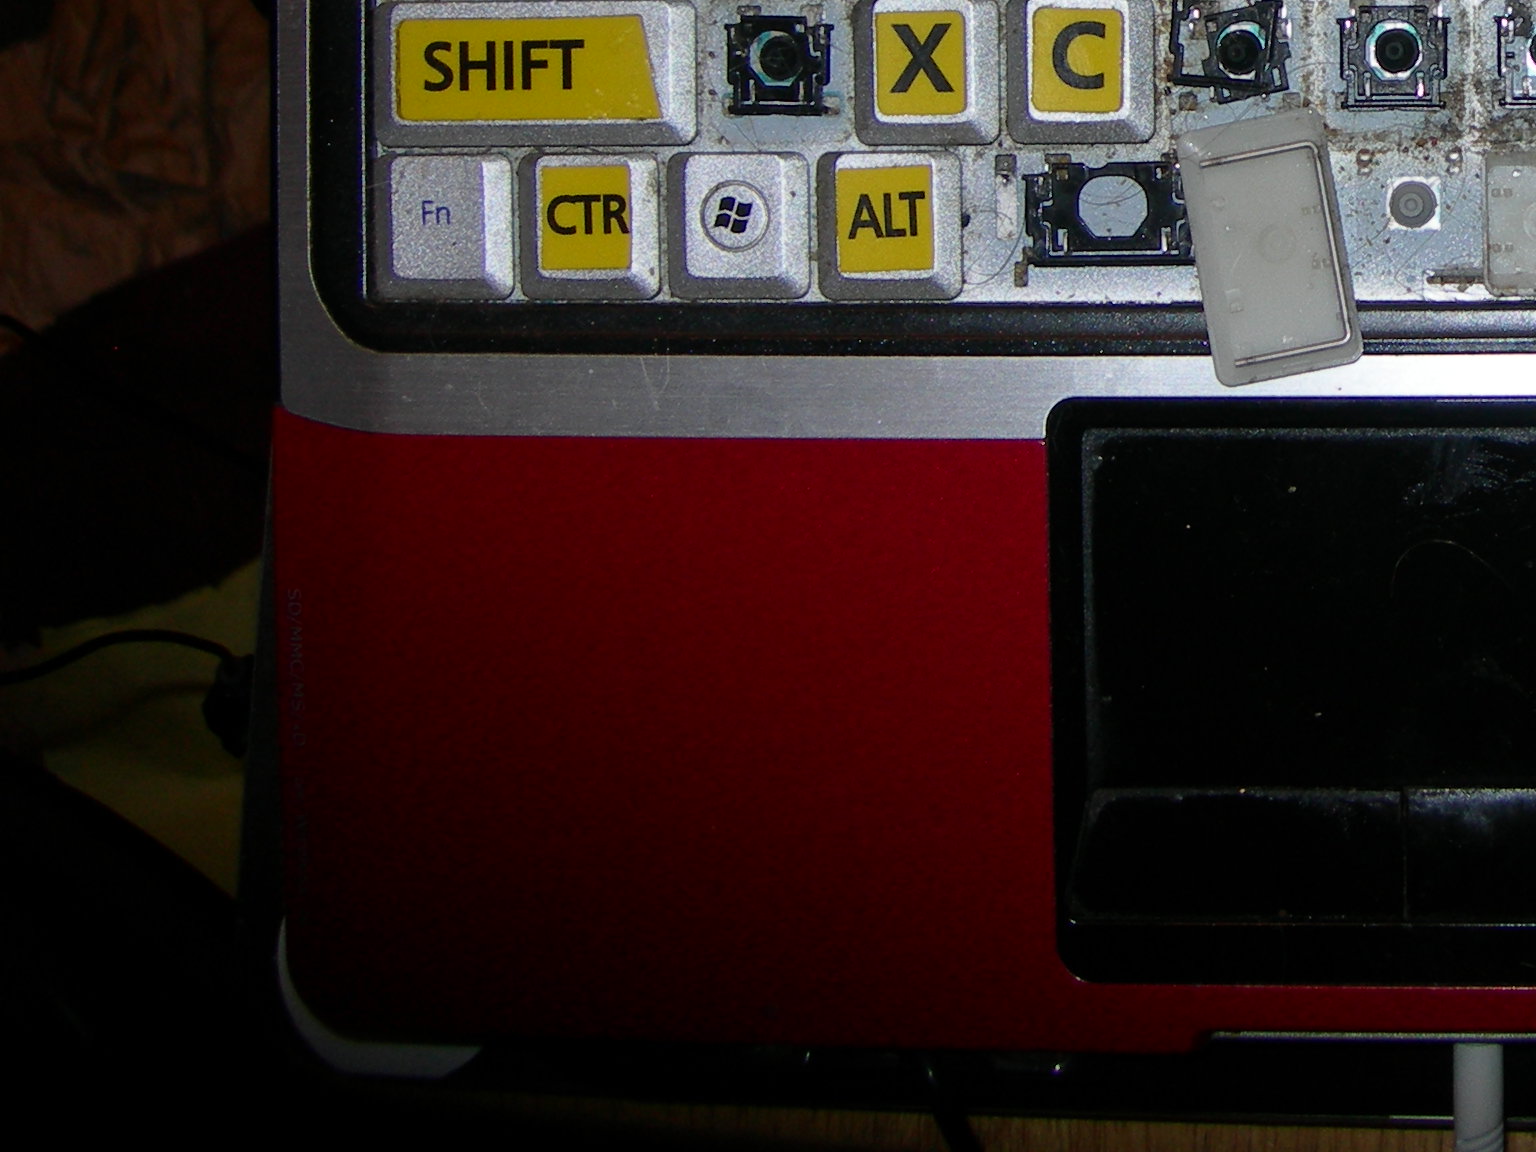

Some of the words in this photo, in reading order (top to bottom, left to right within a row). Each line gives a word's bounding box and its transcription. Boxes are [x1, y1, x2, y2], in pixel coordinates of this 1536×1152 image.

[421, 38, 585, 93] SHIFT
[890, 22, 954, 95] X
[1051, 20, 1107, 92] C
[421, 198, 453, 227] Fn
[545, 195, 631, 238] CTR
[846, 190, 927, 241] ALT
